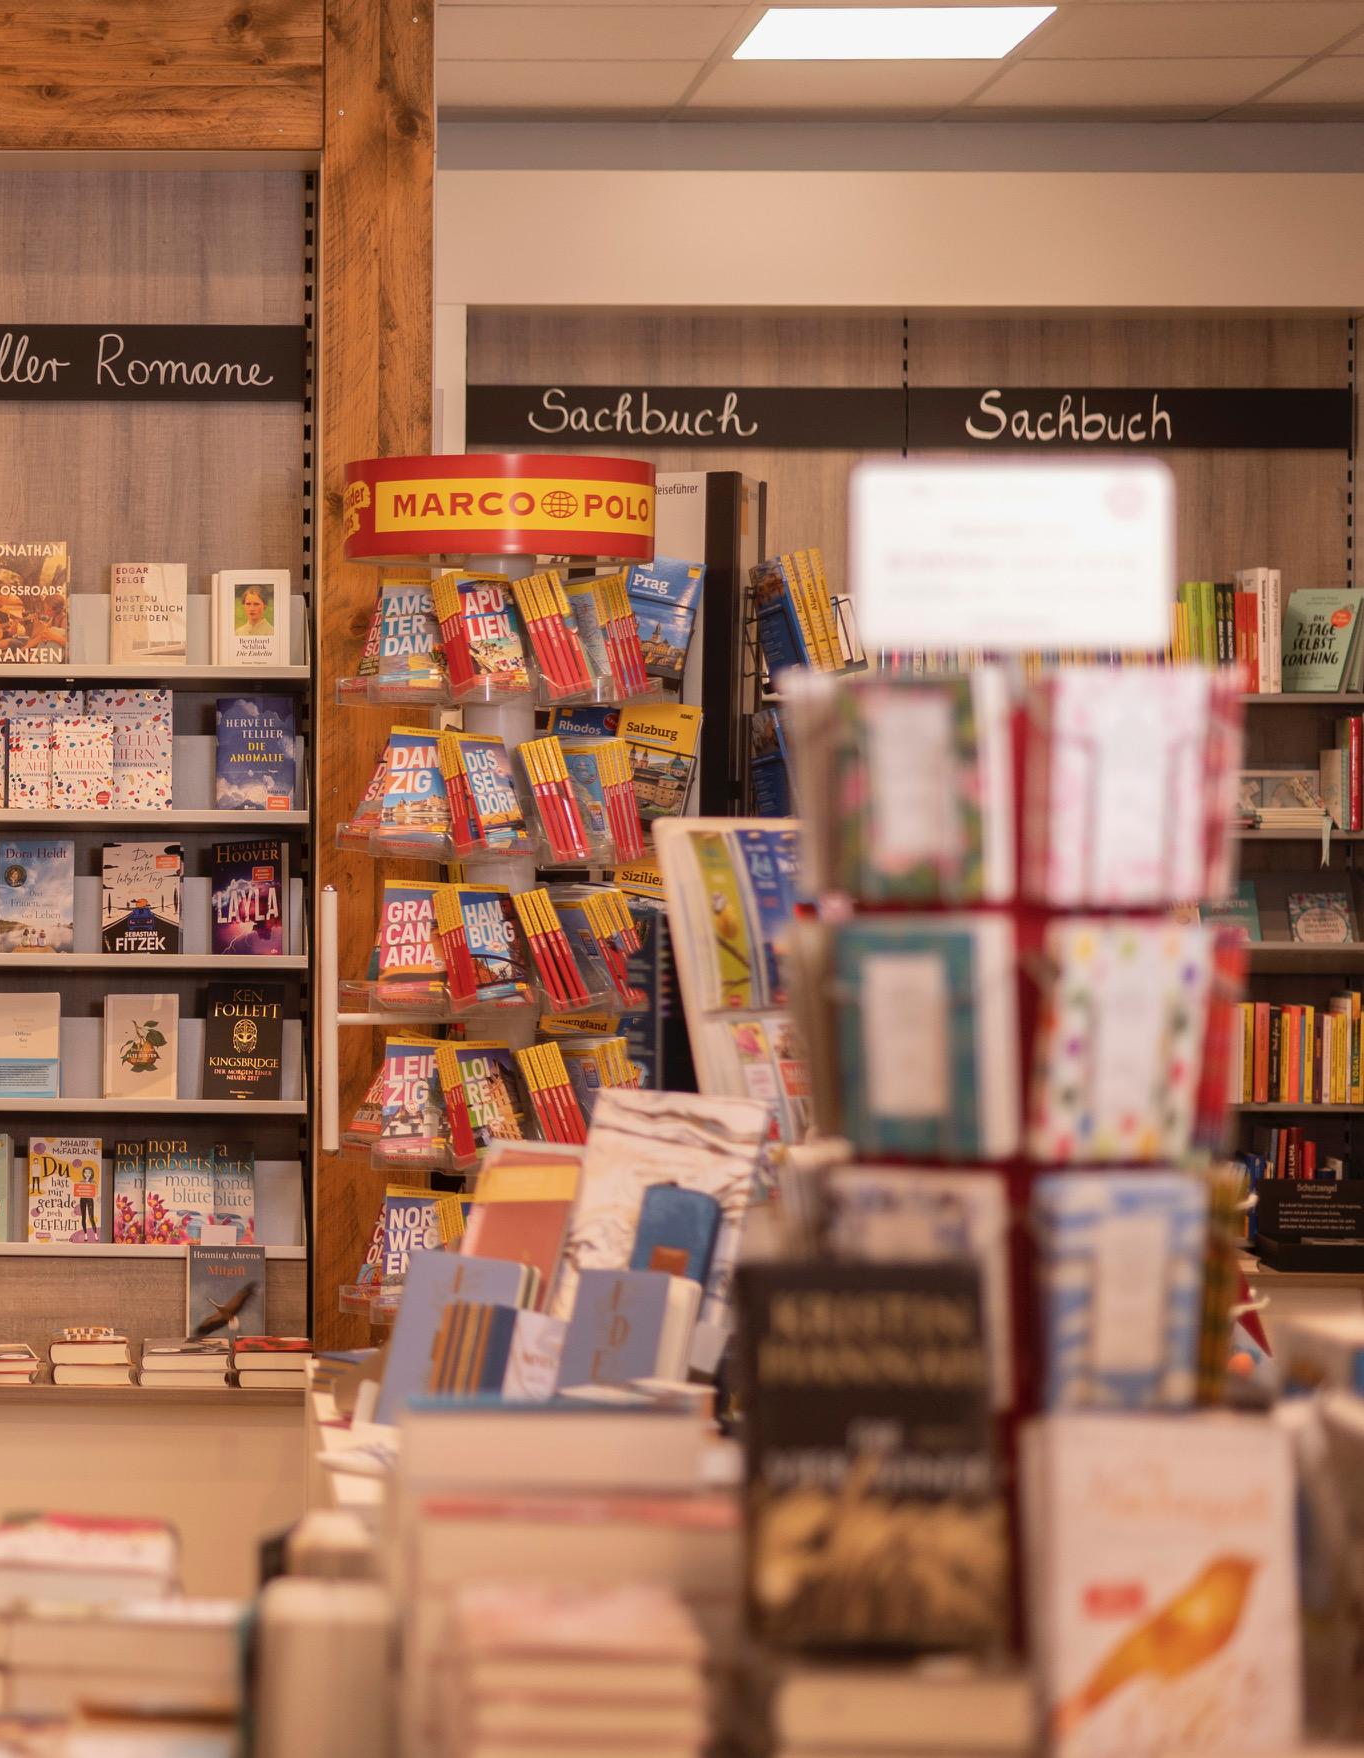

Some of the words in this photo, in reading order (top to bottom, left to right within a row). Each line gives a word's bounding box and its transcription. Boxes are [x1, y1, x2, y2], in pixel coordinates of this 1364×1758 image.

[97, 334, 273, 387] Romane
[528, 389, 757, 436] Sachbuch
[966, 389, 1172, 442] Sachbuch
[393, 492, 535, 517] MARCO
[584, 494, 649, 521] POLO
[633, 574, 670, 594] Prag
[465, 591, 504, 614] APU
[807, 583, 817, 610] Algarve
[386, 614, 427, 637] TER
[467, 614, 510, 641] LIEN
[385, 637, 433, 657] DAM
[1293, 638, 1337, 650] SELBST
[1283, 652, 1339, 666] COACHING
[264, 719, 275, 727] LE
[559, 720, 602, 736] Rhodos
[626, 722, 678, 742] Salzburg
[242, 729, 283, 739] TELLIER
[56, 748, 109, 759] CECELIA
[248, 742, 265, 751] DIE
[63, 759, 105, 770] AHERN
[230, 754, 284, 762] ANOMALIE
[465, 749, 496, 772] DÜS
[389, 770, 433, 794] ZIG
[474, 772, 503, 794] SEL
[478, 793, 516, 816] DORF
[6, 849, 32, 859] Dora
[37, 848, 67, 859] Heldt
[216, 846, 279, 863] HOOVER
[217, 888, 278, 923] LAYLA
[464, 901, 503, 925] HAM
[35, 911, 61, 919] Leben
[386, 922, 431, 945] CAN
[470, 922, 515, 948] BURG
[116, 937, 165, 951] FITZEK
[384, 945, 435, 967] ARIA
[233, 990, 263, 1002] KEN
[214, 1004, 280, 1018] FOLLETT
[209, 1058, 279, 1069] KINGSBRIDGE
[462, 1056, 491, 1083] LOI
[386, 1080, 429, 1106] ZIG
[467, 1083, 490, 1105] RE
[471, 1104, 504, 1123] TAL
[148, 1140, 187, 1153] nora
[43, 1157, 70, 1177] Du
[148, 1153, 211, 1171] roberts
[51, 1178, 69, 1187] hast
[165, 1174, 210, 1186] mond
[48, 1188, 63, 1196] mir
[173, 1189, 211, 1203] blüte
[37, 1195, 76, 1213] gerade
[34, 1220, 79, 1231] GEFEHLT
[194, 1251, 228, 1261] Henning
[208, 1265, 246, 1277] Mitgift
